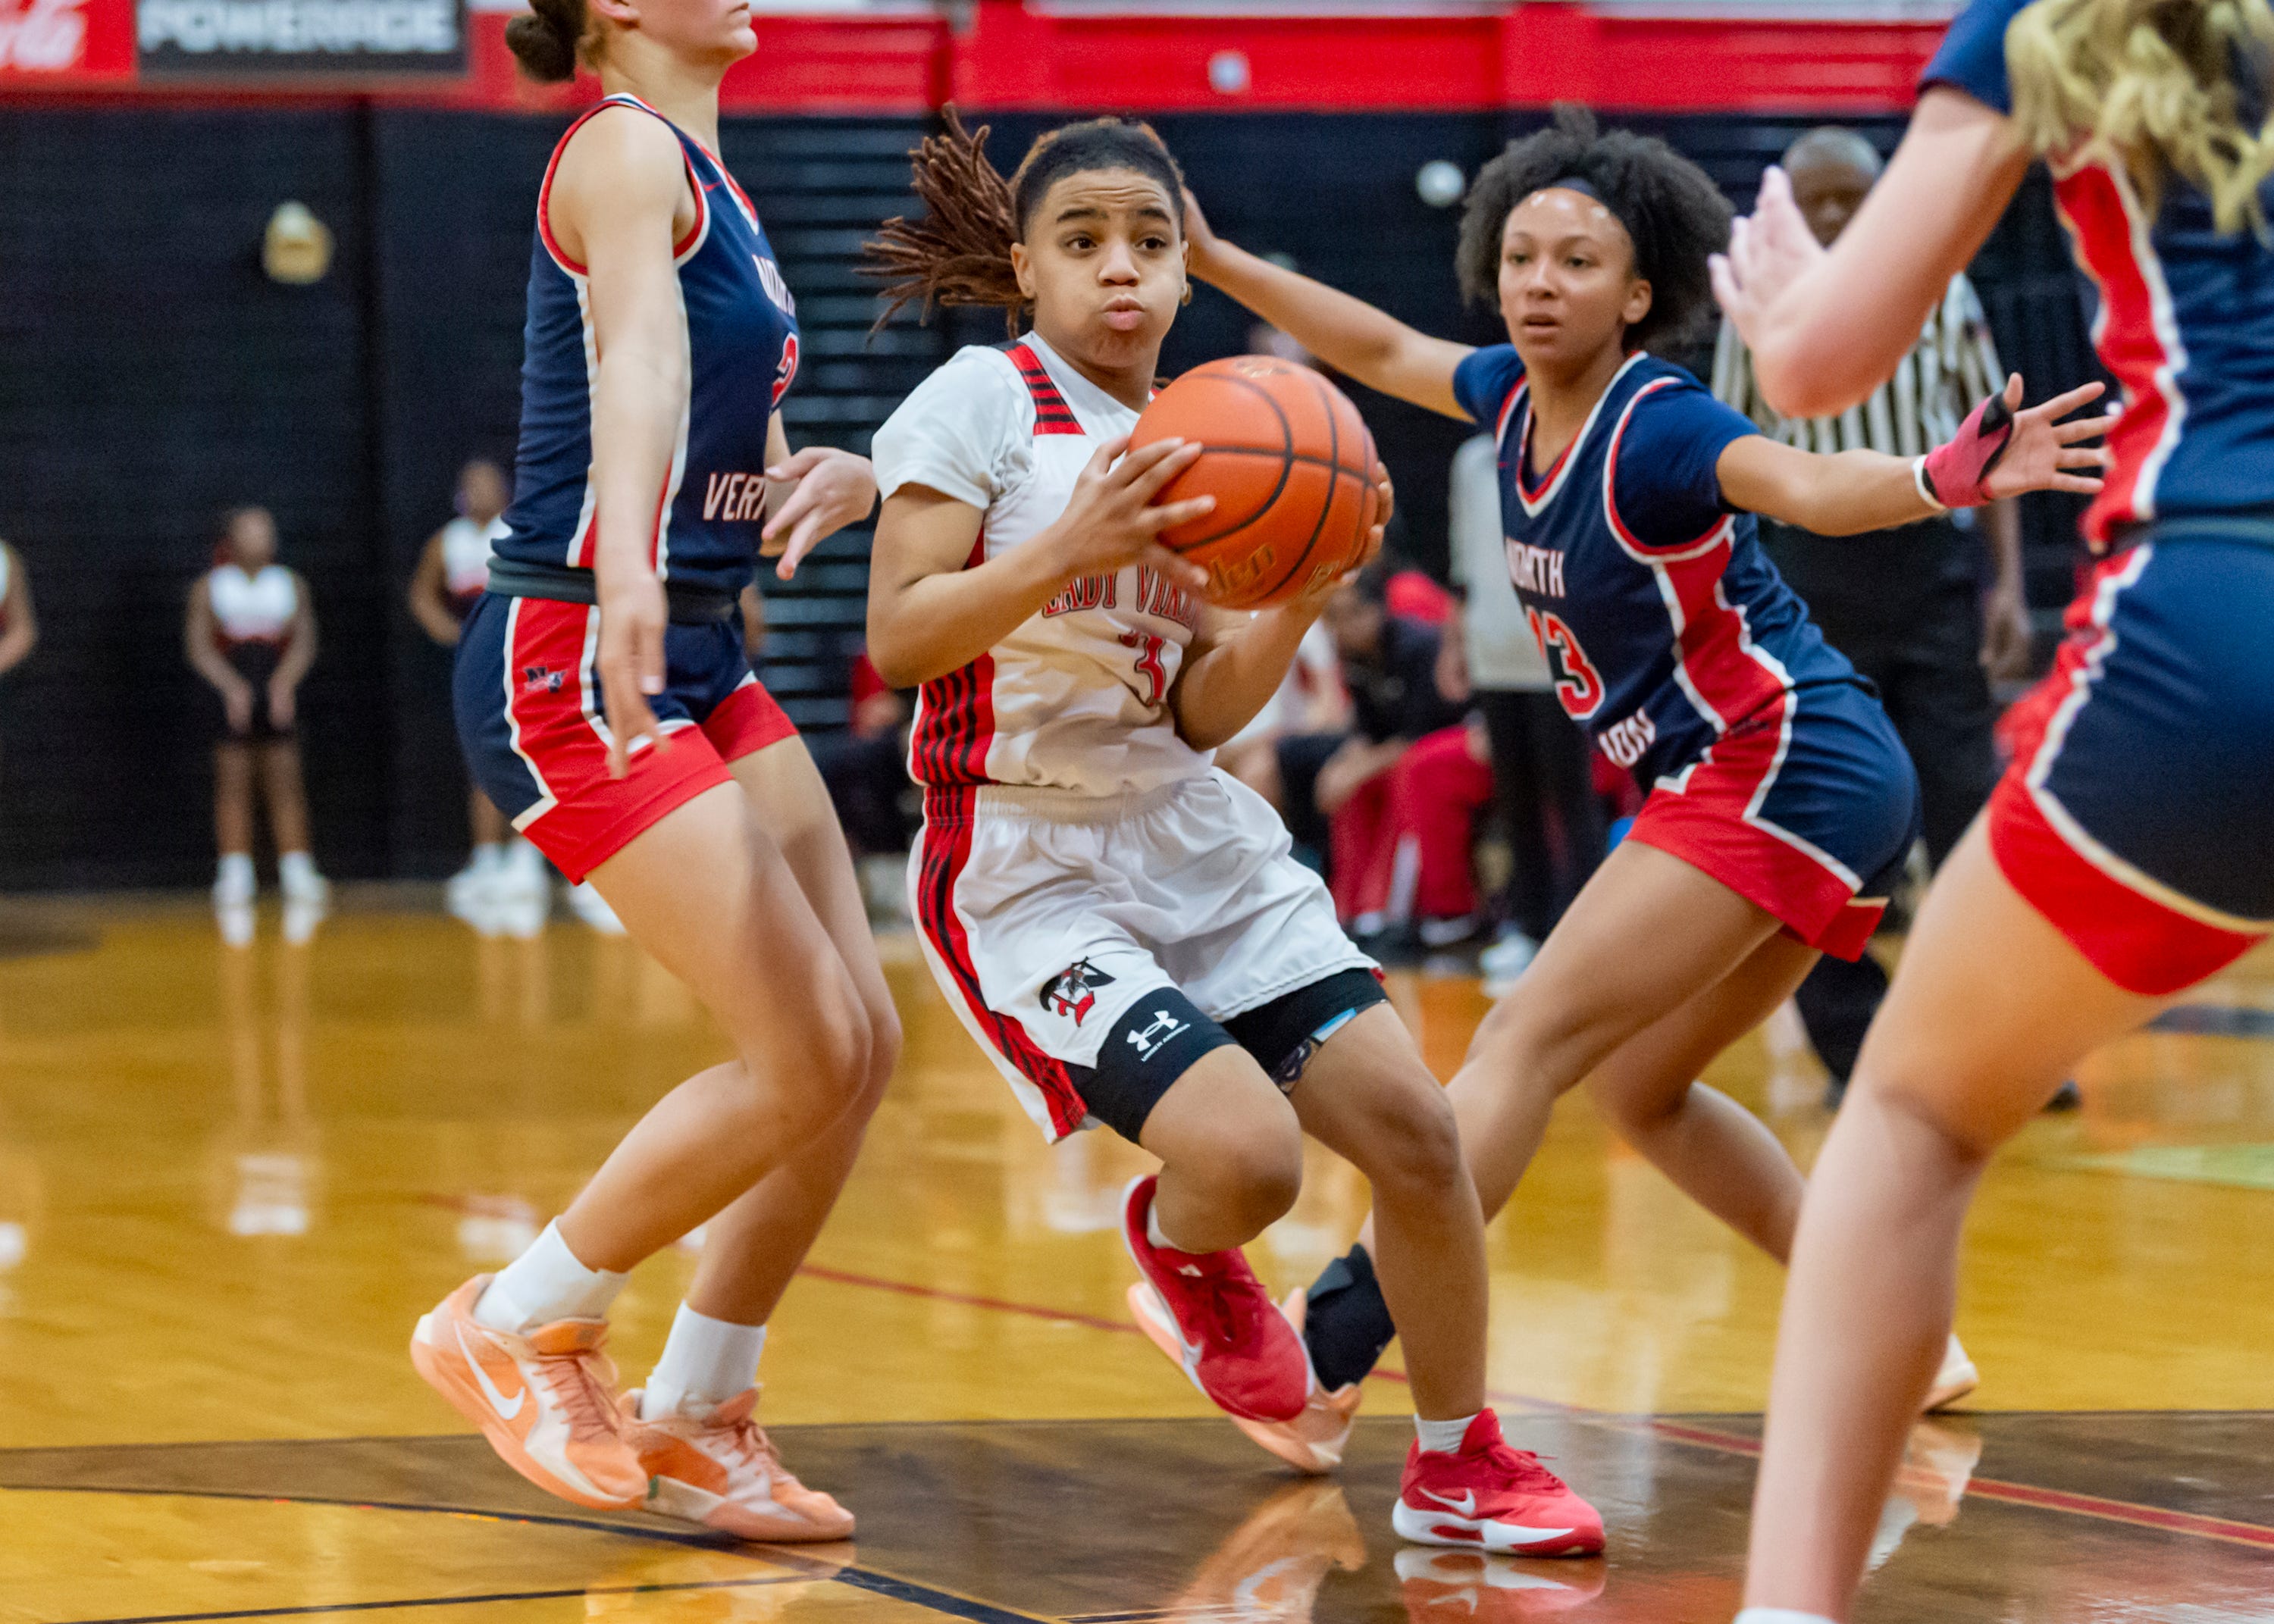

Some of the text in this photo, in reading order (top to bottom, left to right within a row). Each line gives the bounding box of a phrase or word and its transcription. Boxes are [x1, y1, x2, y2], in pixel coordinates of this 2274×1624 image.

[772, 331, 800, 409] 2
[1505, 537, 1566, 599] NORTH
[1117, 630, 1166, 708] 3
[1524, 605, 1606, 721] 13
